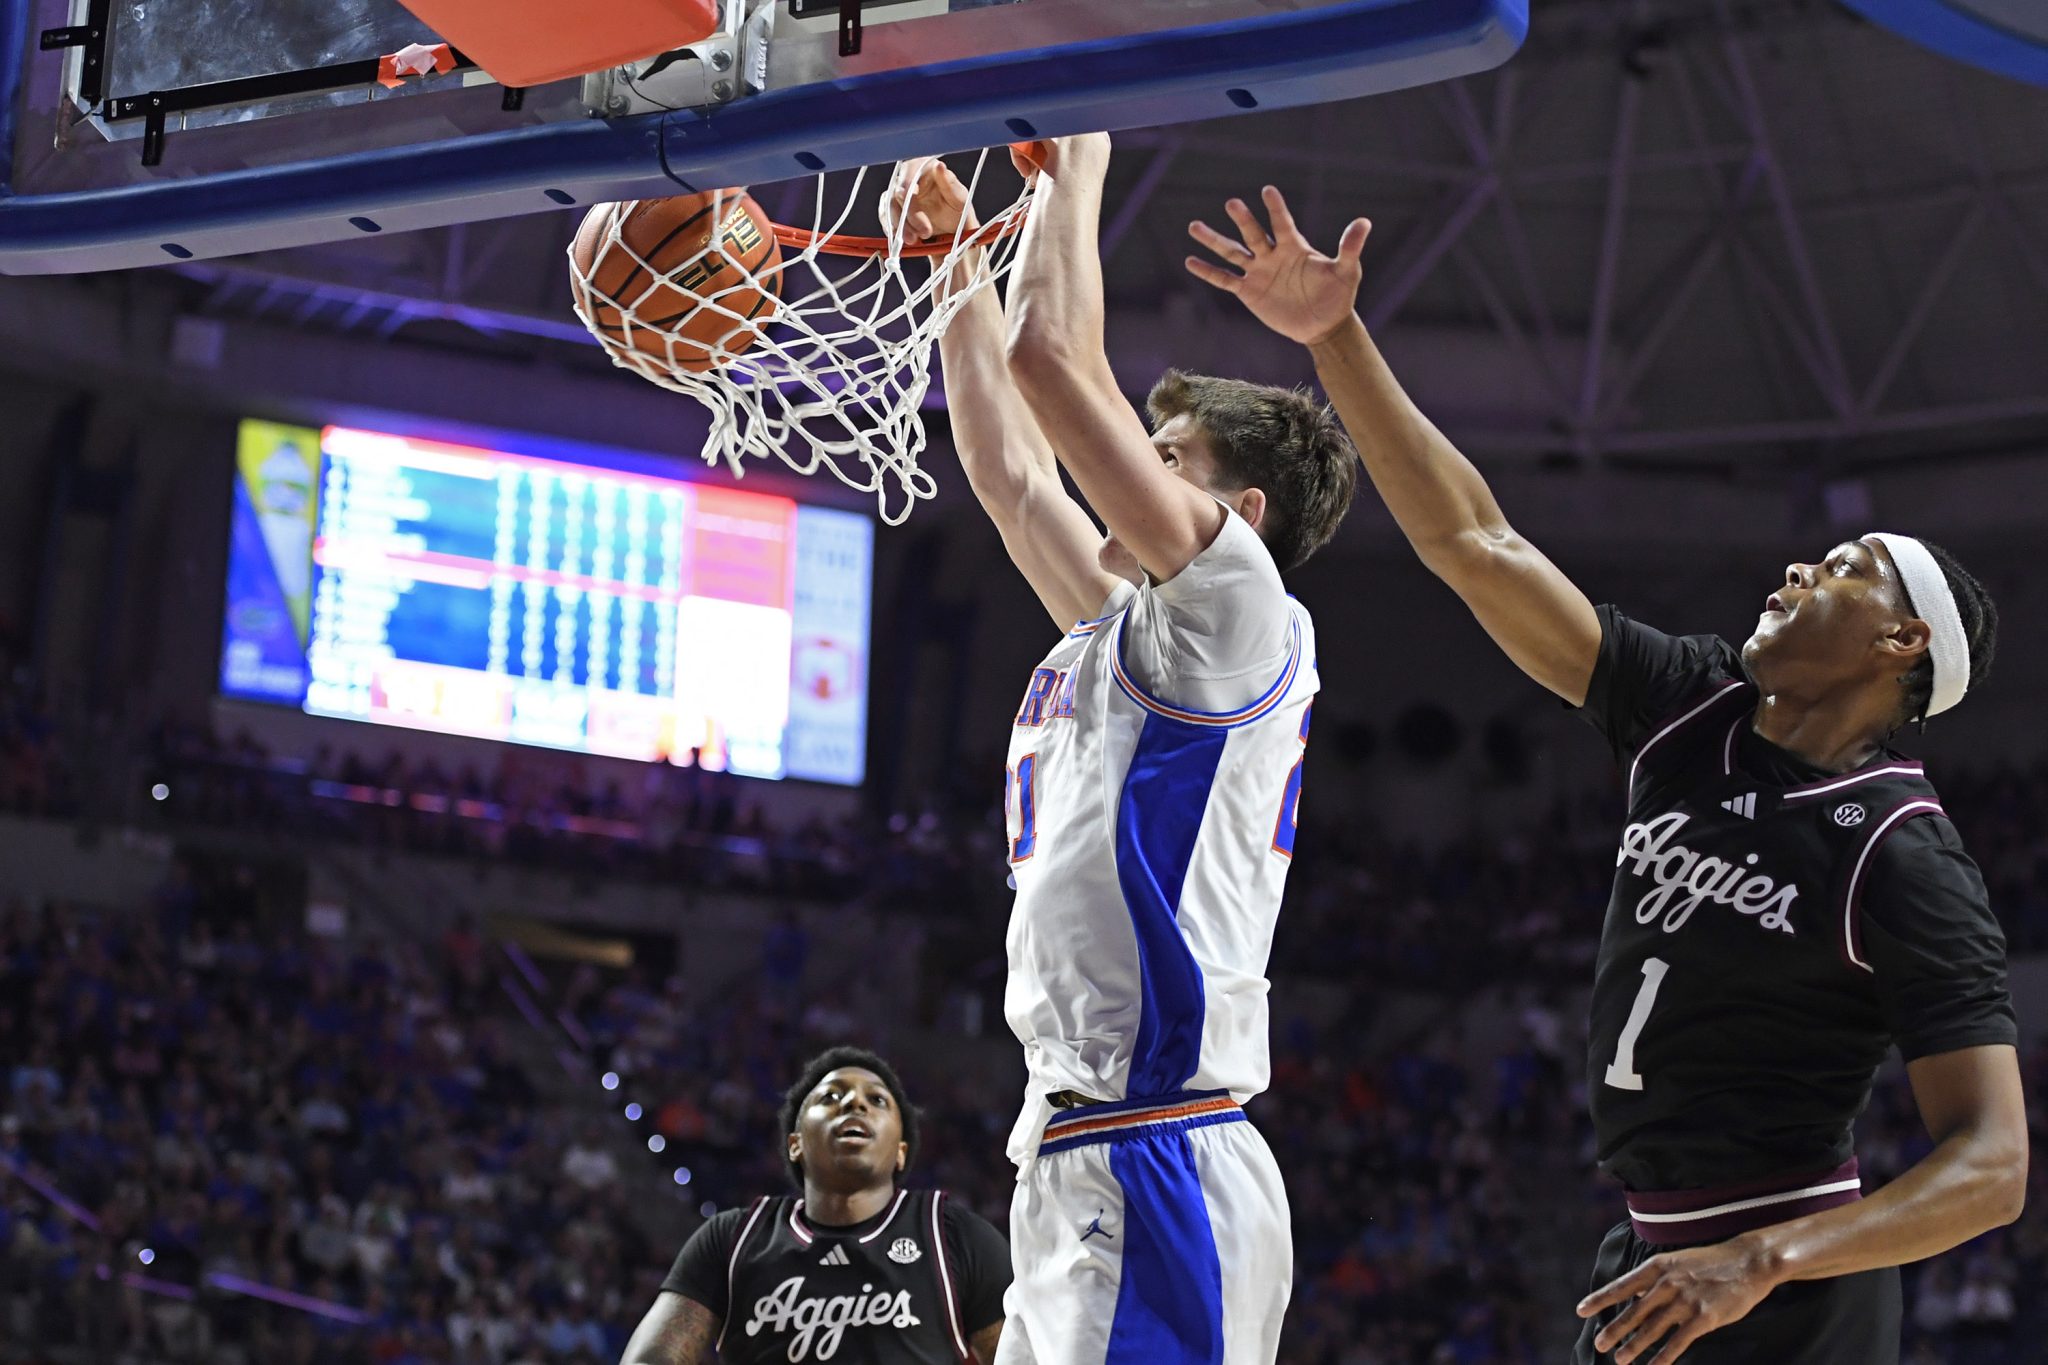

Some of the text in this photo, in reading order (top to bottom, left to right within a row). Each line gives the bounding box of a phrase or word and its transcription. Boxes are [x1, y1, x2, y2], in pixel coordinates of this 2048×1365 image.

[1836, 805, 1865, 825] SEC
[1616, 812, 1799, 934] Aggies
[1604, 957, 1670, 1091] 1
[893, 1239, 914, 1257] SEC
[745, 1276, 921, 1363] Aggies
